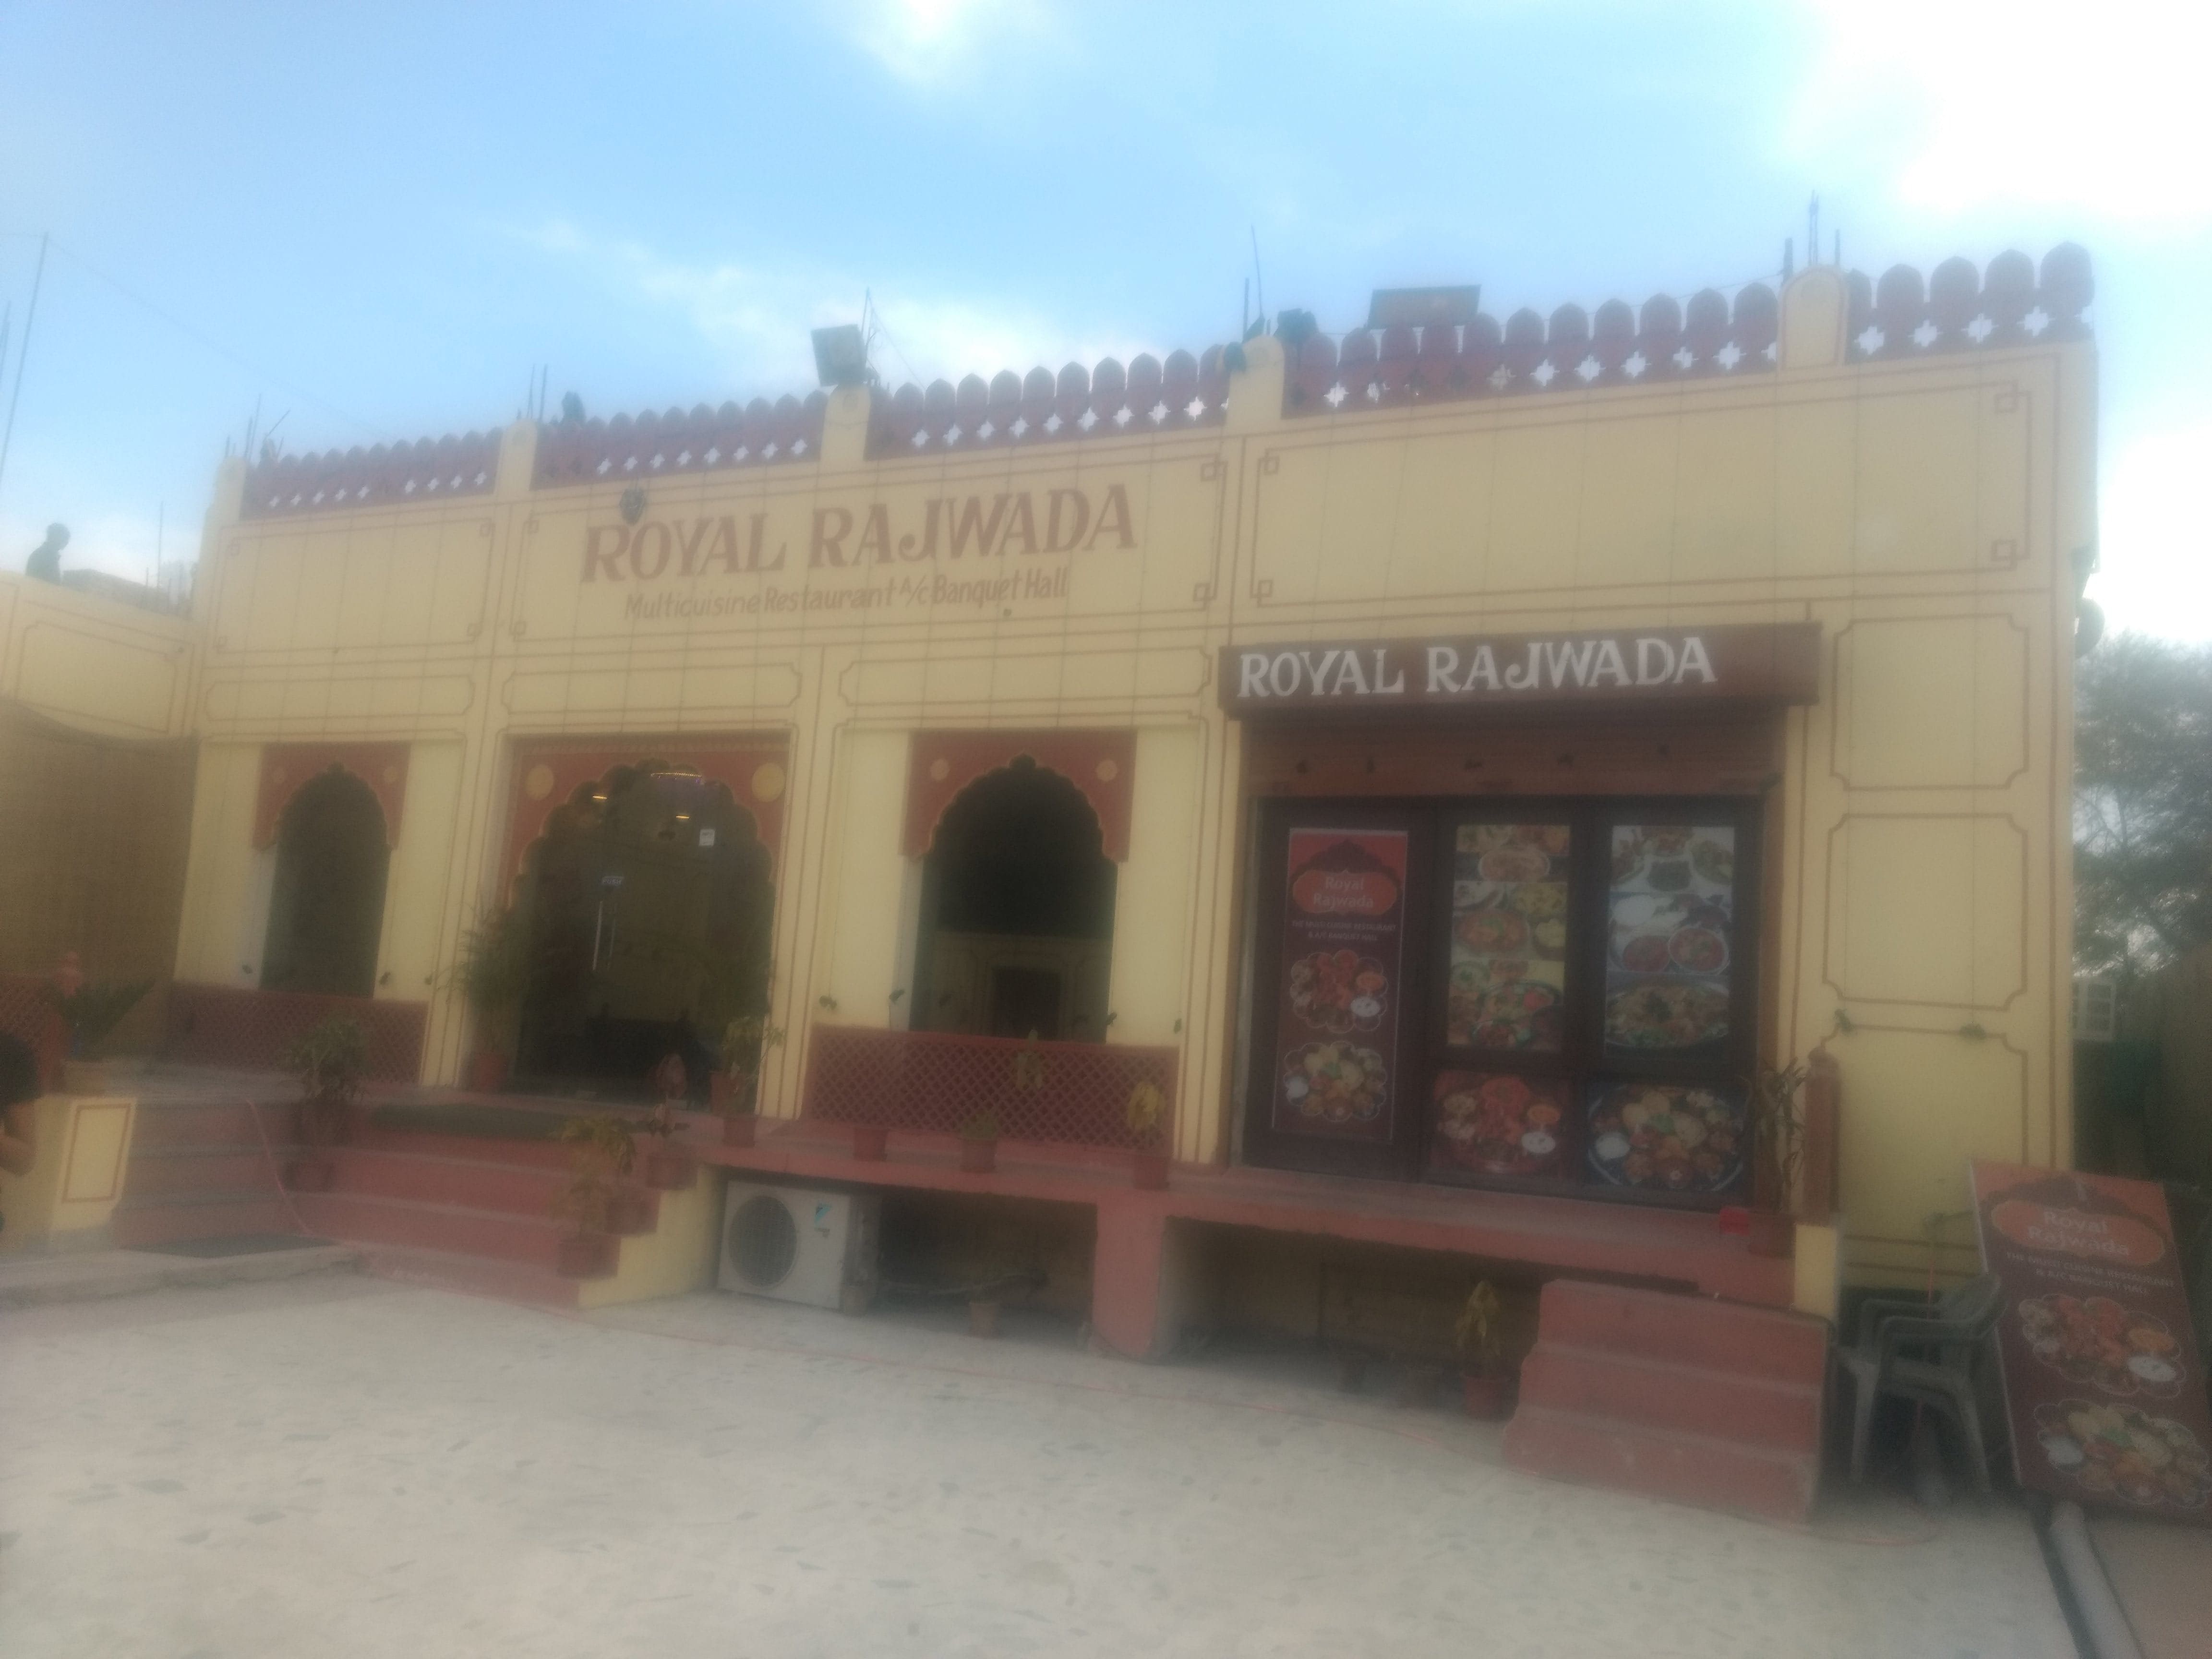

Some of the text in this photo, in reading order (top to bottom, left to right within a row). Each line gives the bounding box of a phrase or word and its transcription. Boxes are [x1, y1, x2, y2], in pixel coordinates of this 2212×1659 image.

[580, 484, 1139, 583] ROYAL RAJWADA
[625, 589, 761, 620] Multicuisine
[764, 577, 897, 612] Restaurant
[932, 572, 1022, 607] Banquet
[1025, 567, 1068, 598] Hall
[1238, 636, 1718, 698] ROYAL RAJWADA
[1325, 876, 1365, 893] Royal
[1313, 892, 1374, 910] Rajwada
[2044, 1211, 2108, 1234] Royal
[2027, 1226, 2130, 1256] Rajwada
